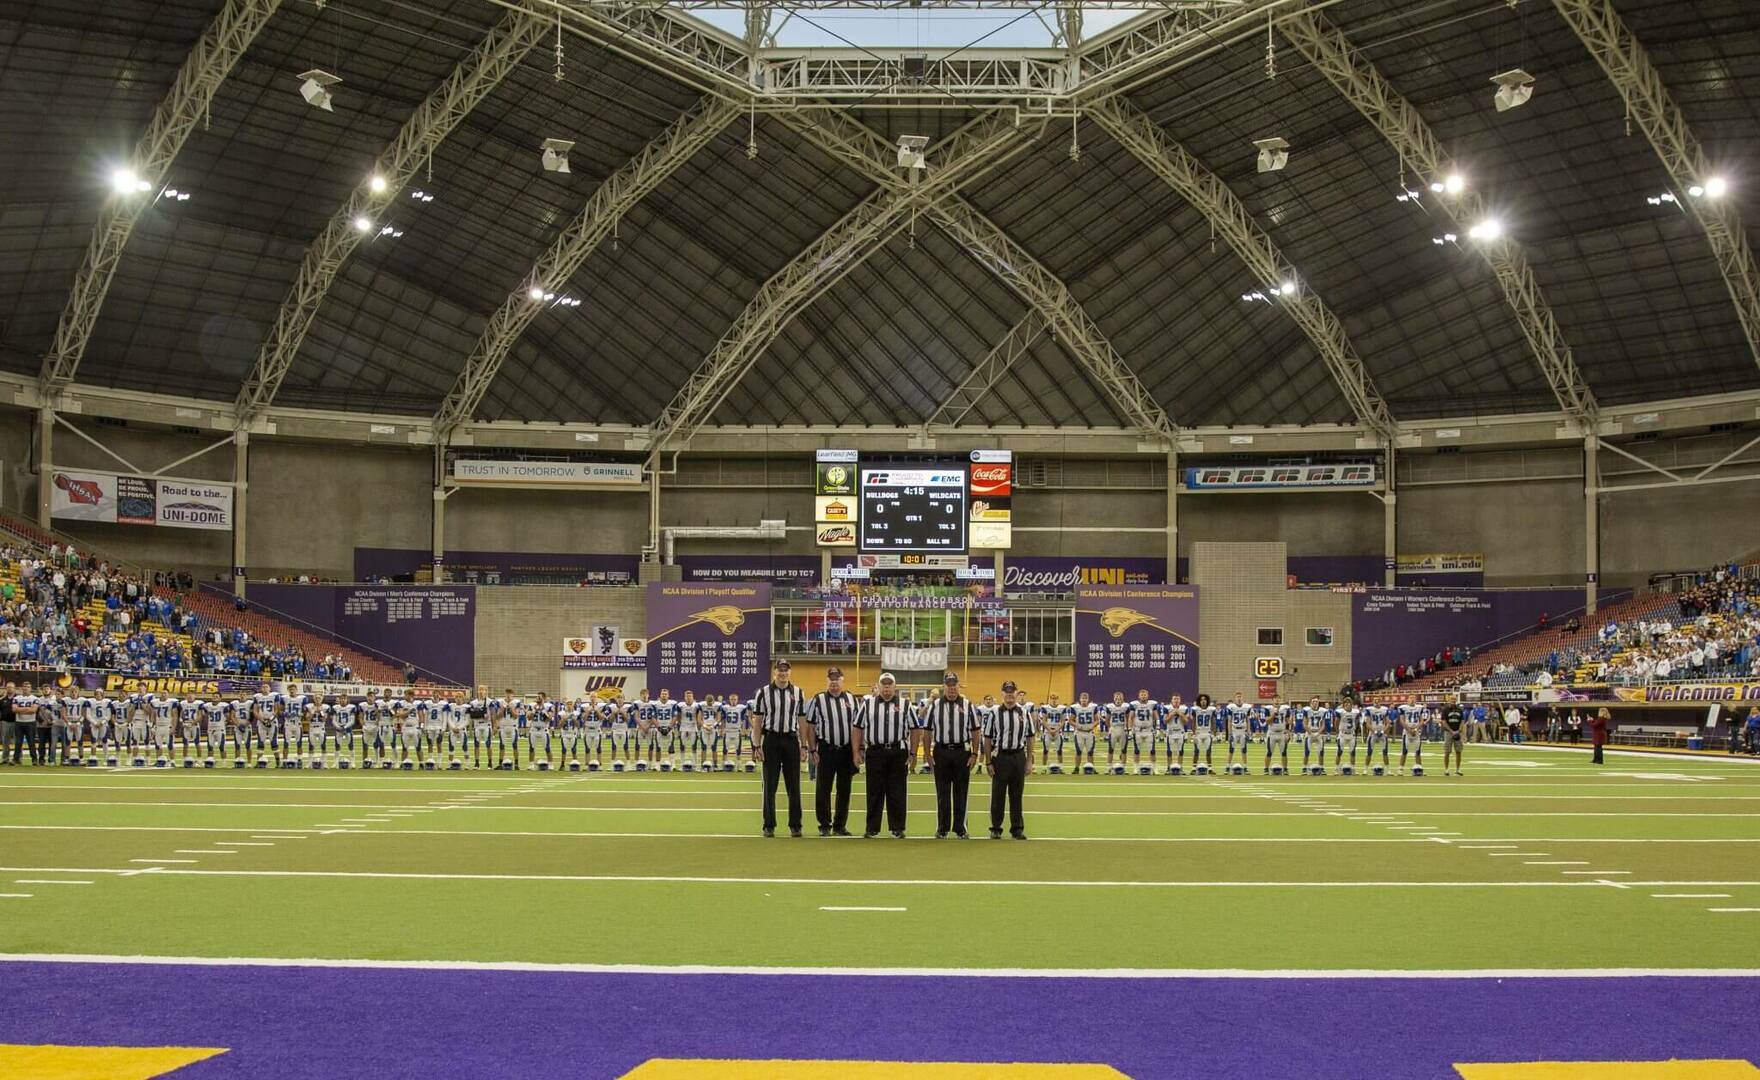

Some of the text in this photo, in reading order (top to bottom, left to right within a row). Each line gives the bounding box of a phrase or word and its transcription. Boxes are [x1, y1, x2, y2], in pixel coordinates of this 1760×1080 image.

[462, 465, 576, 477] TRUST IN TOMORROW
[593, 468, 635, 476] GRINNELL
[69, 481, 96, 503] IHSAA
[162, 485, 228, 499] Road to the...
[904, 487, 924, 495] 4:15
[876, 504, 884, 513] 0
[946, 504, 953, 513] 0
[162, 509, 226, 524] UNI-DOME
[1442, 561, 1482, 570] uni.edu
[1004, 566, 1082, 586] Discover
[1081, 568, 1125, 584] UNI
[709, 588, 730, 597] Playoff
[1260, 660, 1278, 674] 25
[106, 674, 219, 694] Panthers
[585, 676, 627, 692] UNI
[1645, 684, 1760, 701] Welcome to
[68, 704, 80, 715] 71
[96, 706, 102, 718] 6
[155, 706, 168, 716] 77
[259, 701, 272, 712] 75
[288, 703, 299, 714] 15
[239, 708, 246, 719] 5
[365, 711, 376, 721] 16
[431, 709, 438, 720] 8
[455, 711, 461, 722] 9
[658, 709, 670, 720] 52
[704, 711, 716, 719] 34
[726, 712, 738, 724] 63
[1078, 713, 1092, 724] 65
[1112, 713, 1125, 722] 26
[1138, 710, 1150, 721] 51
[1406, 712, 1419, 723] 70
[1311, 716, 1322, 727] 17
[1347, 718, 1353, 729] 3
